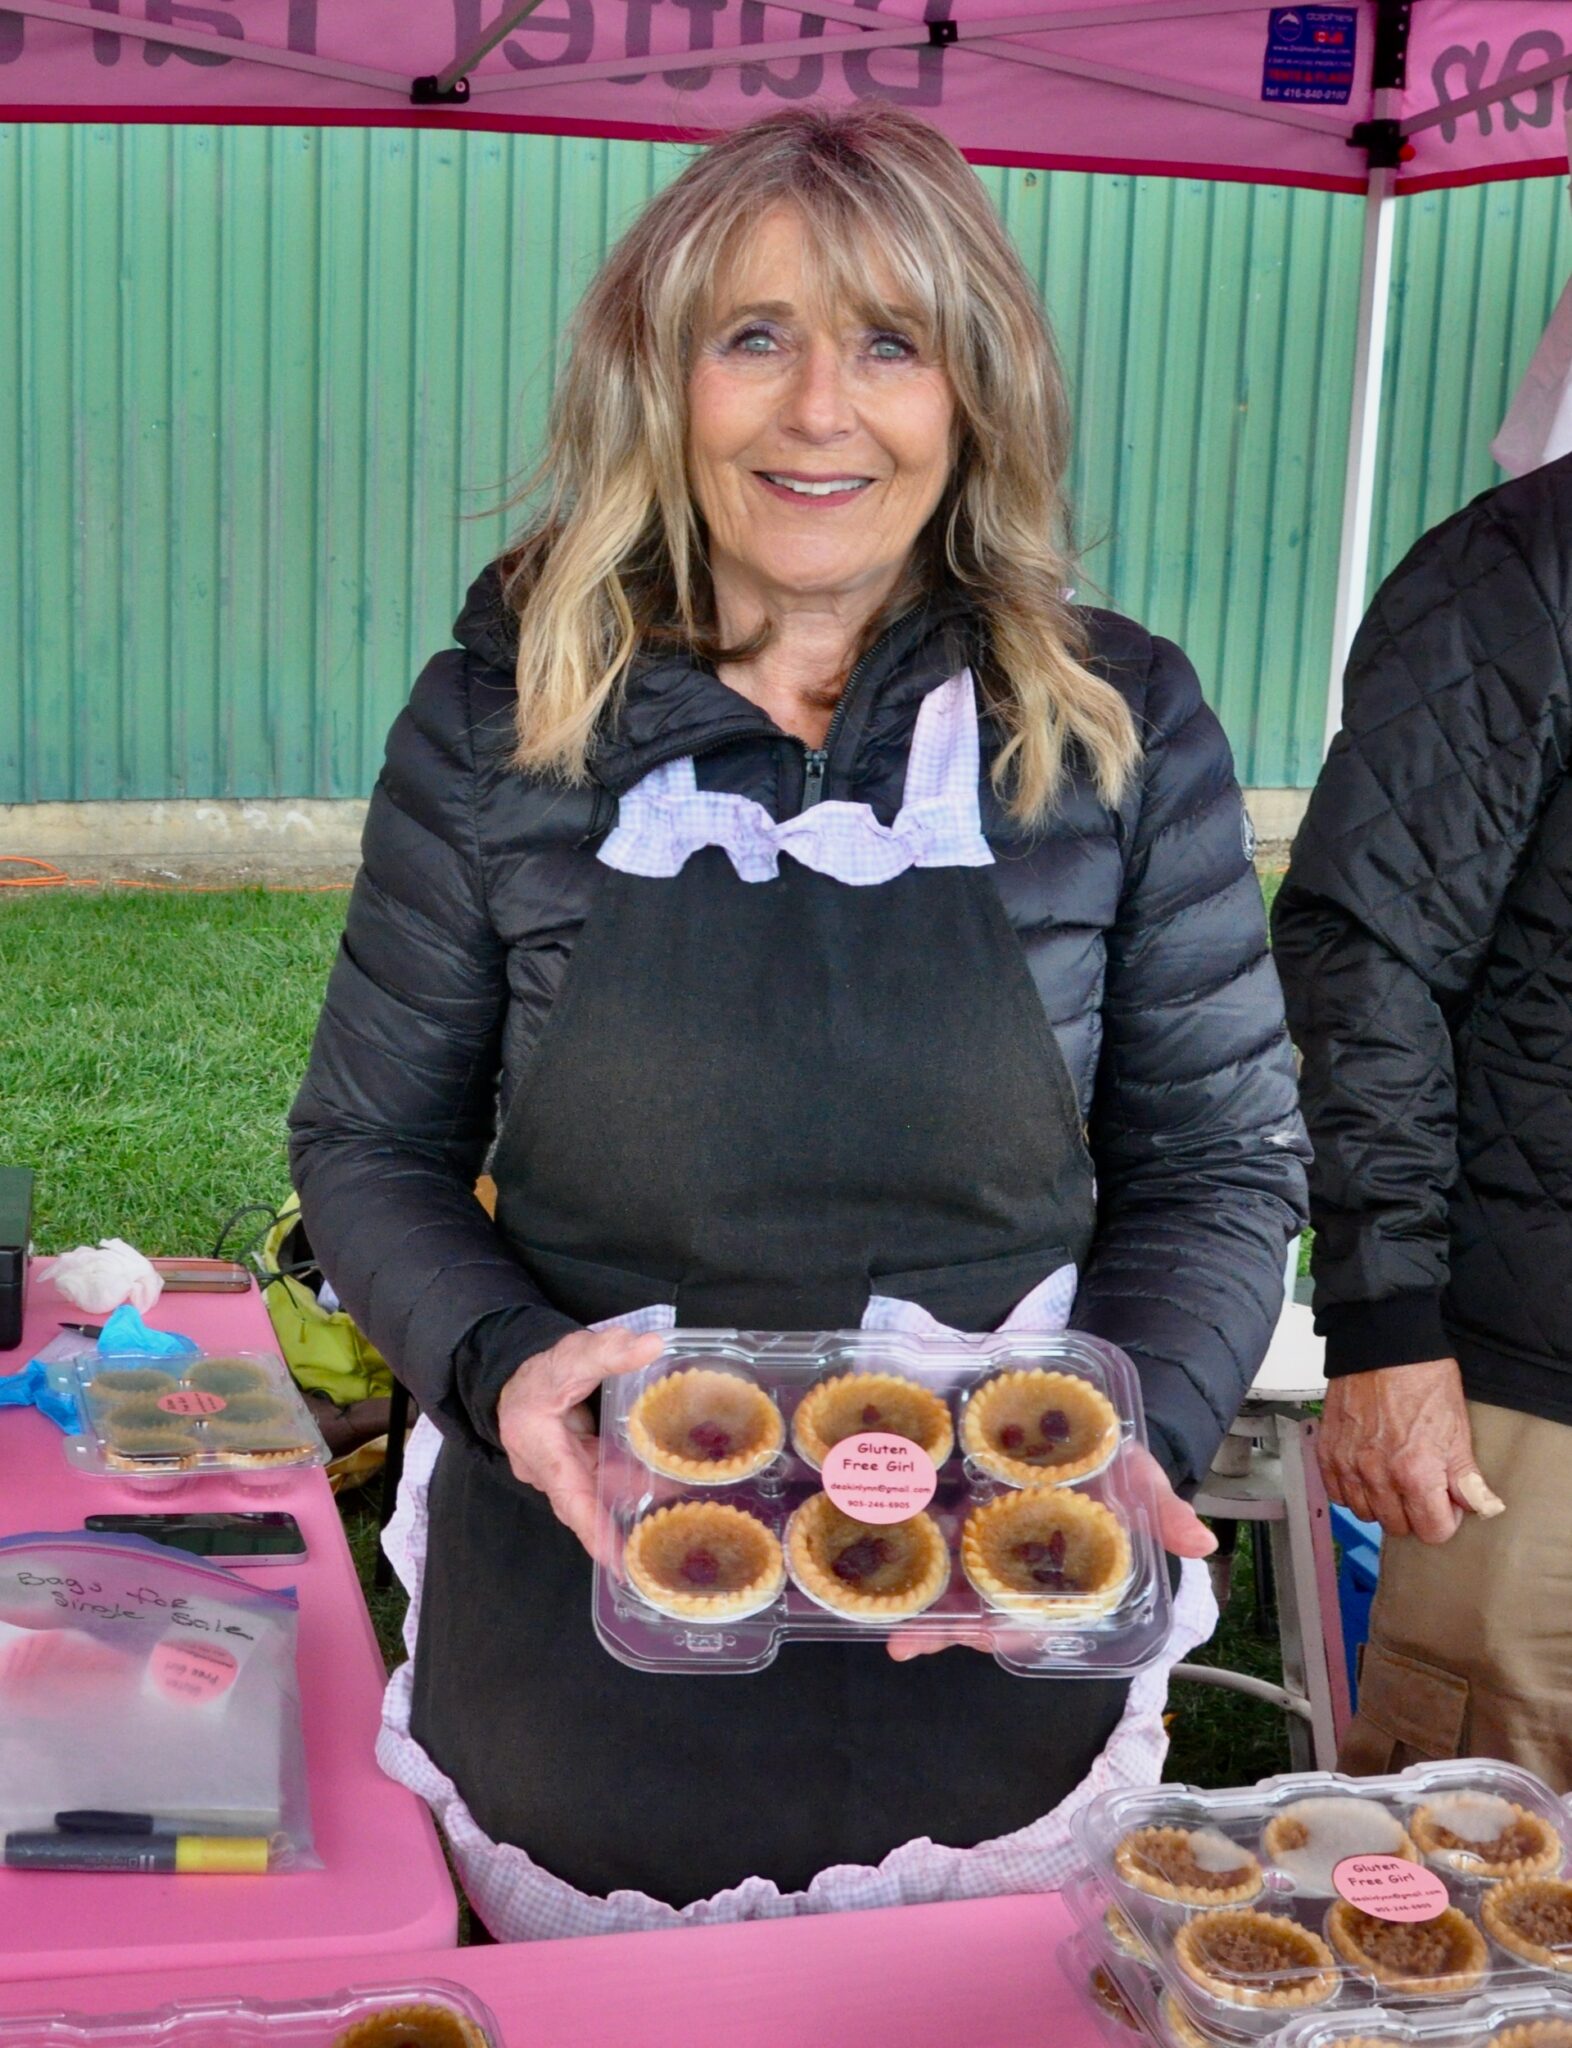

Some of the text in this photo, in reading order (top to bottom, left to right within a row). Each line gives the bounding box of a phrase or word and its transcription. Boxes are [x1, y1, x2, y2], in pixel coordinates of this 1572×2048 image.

[857, 1443, 908, 1455] Gluten
[842, 1458, 914, 1472] Free Girl
[1352, 1863, 1400, 1874] Gluten
[1347, 1873, 1415, 1887] Free Girl
